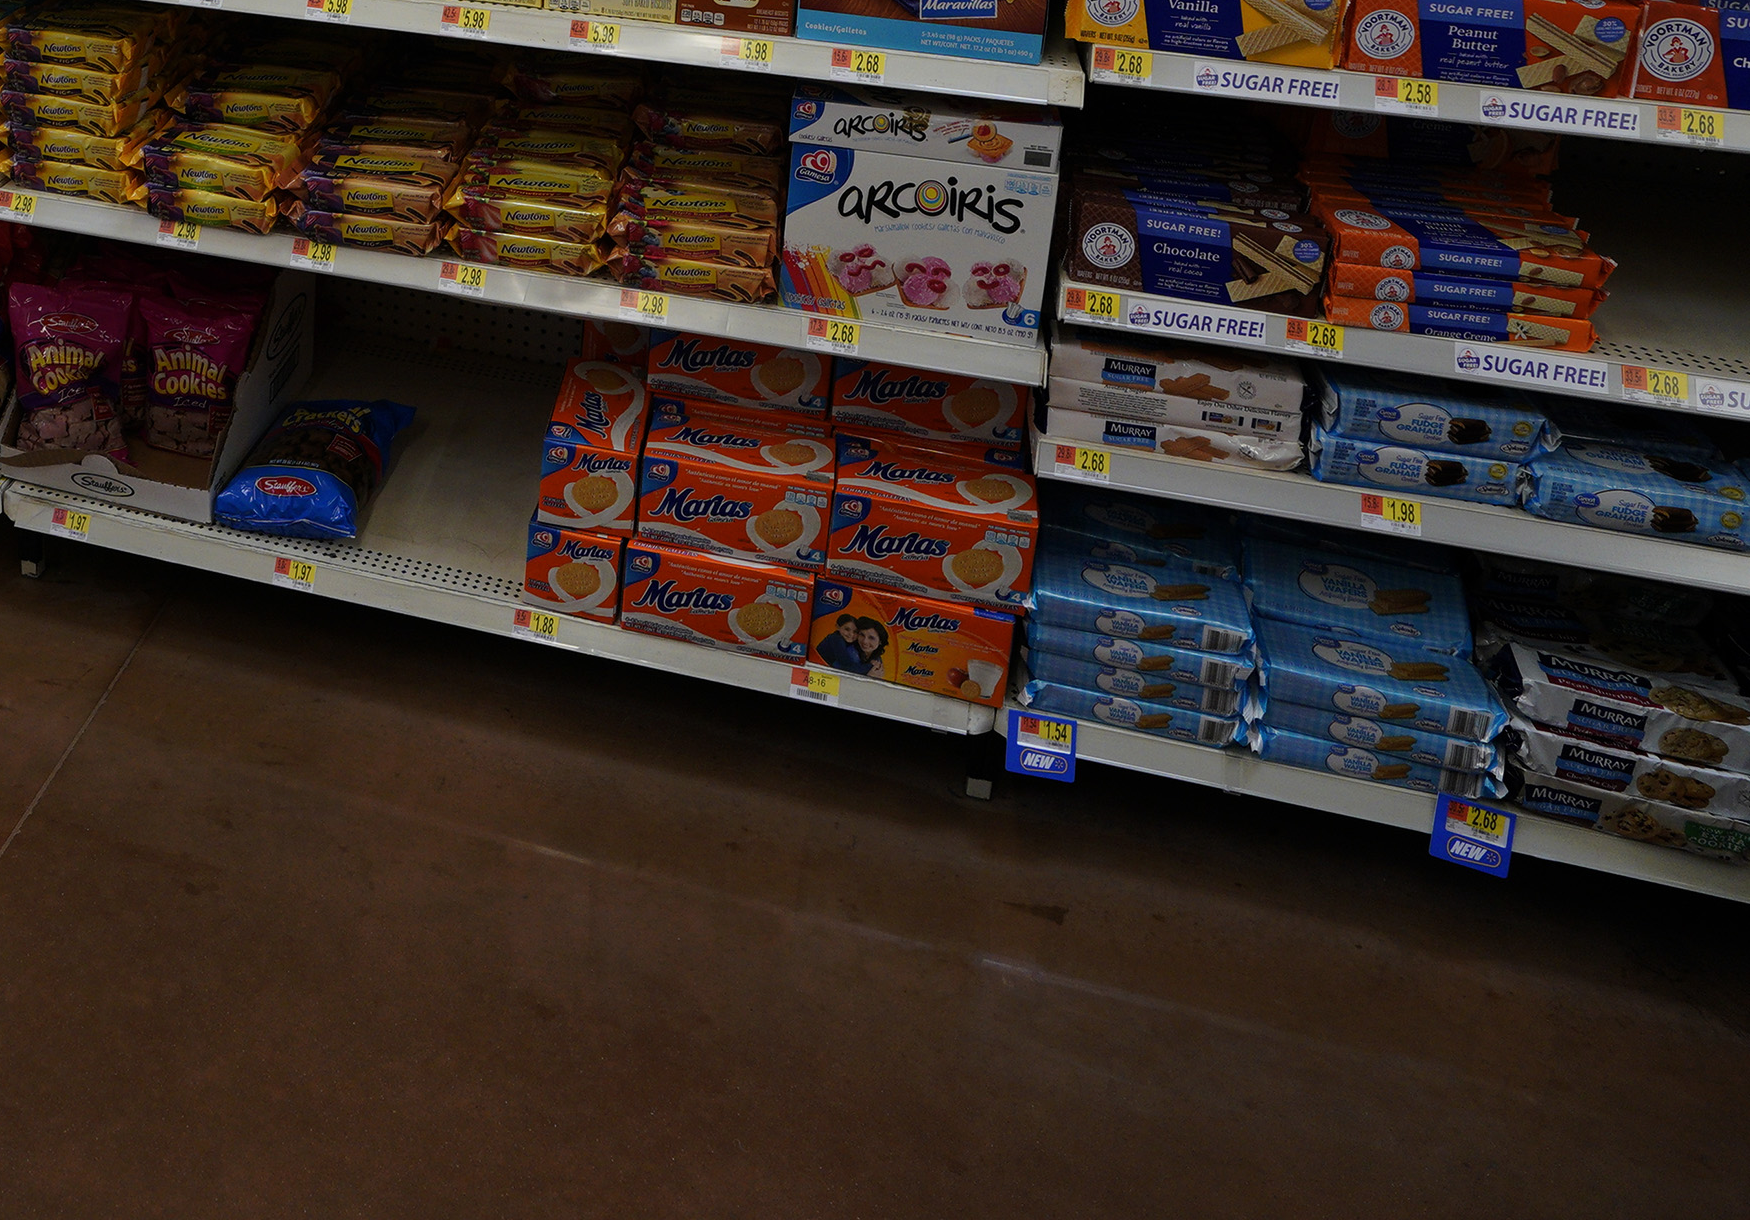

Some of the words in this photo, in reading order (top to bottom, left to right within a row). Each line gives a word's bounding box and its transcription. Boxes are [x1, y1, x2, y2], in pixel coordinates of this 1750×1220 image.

[1448, 25, 1498, 39] Peanut
[45, 44, 81, 52] Newtons
[1452, 37, 1497, 52] Butter
[1221, 72, 1282, 93] SUGAR
[1287, 76, 1338, 99] FREE!
[1153, 243, 1220, 261] Chocolate
[156, 349, 226, 381] Animal
[1483, 355, 1548, 379] SUGAR
[1552, 361, 1606, 387] FREE!
[154, 375, 227, 401] Cookies
[1451, 843, 1483, 860] NEW
